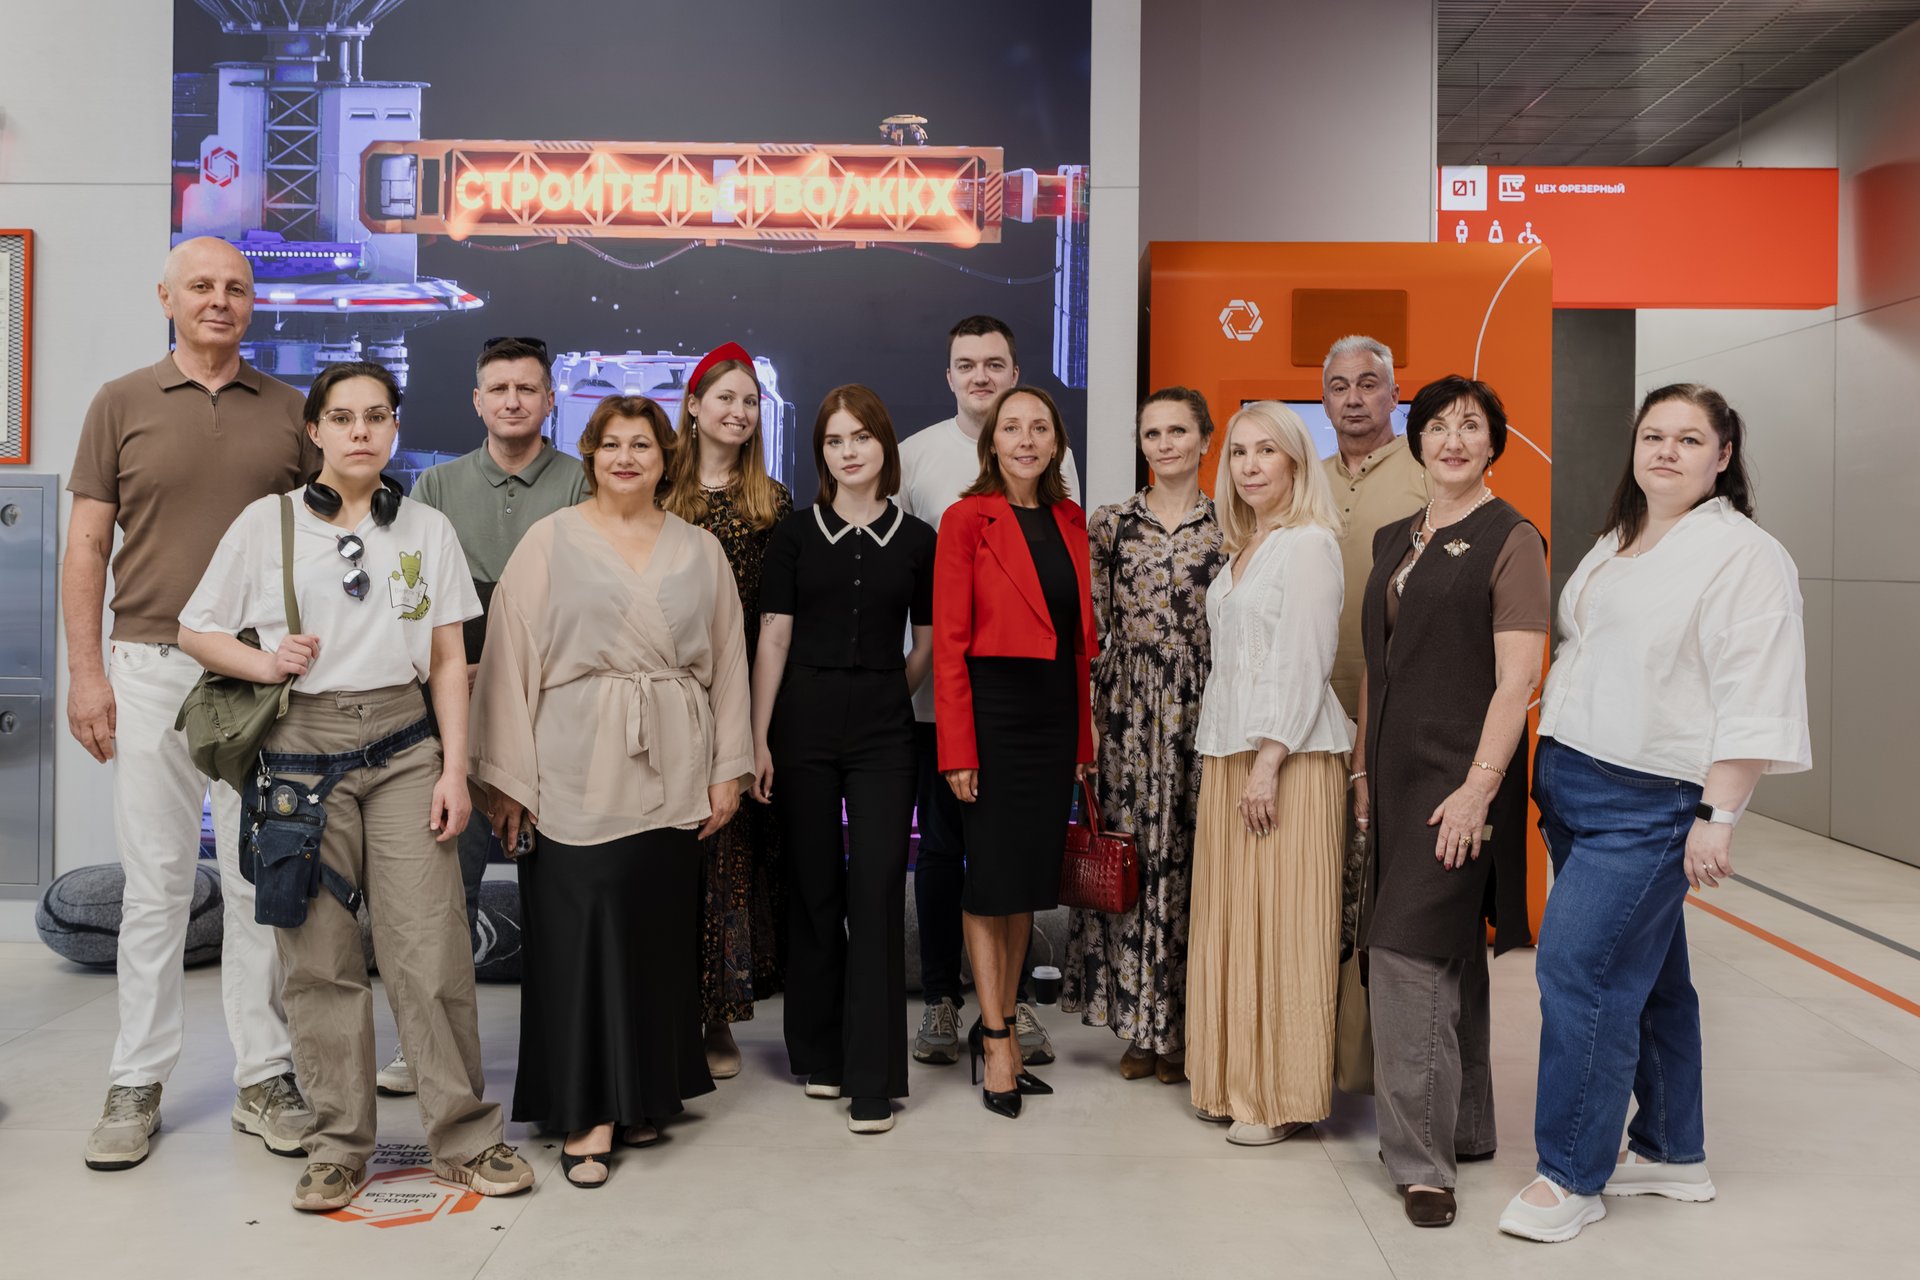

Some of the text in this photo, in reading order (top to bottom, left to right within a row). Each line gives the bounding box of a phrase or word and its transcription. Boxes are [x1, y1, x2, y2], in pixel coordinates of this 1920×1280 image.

[456, 171, 957, 217] СТРОИТЕЛЬСТВО/ЖКХ
[1535, 183, 1625, 194] ЦЕХ ФРЕЗЕРНЫЙ
